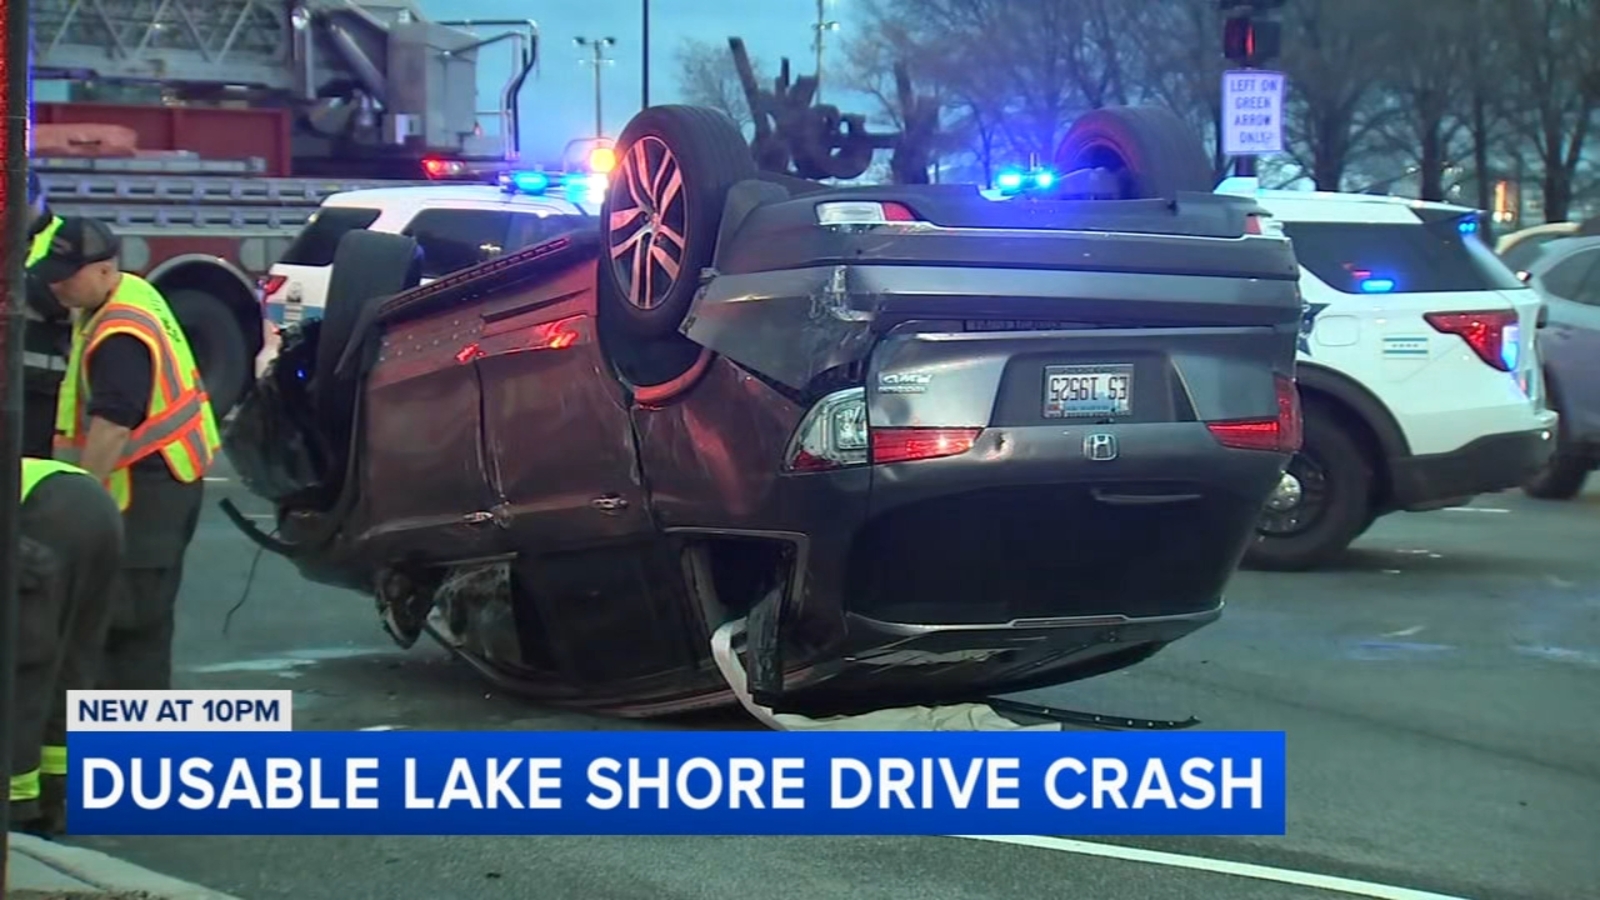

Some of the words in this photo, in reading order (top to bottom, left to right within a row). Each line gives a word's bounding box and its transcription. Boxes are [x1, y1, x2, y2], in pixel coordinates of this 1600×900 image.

[1230, 79, 1256, 93] LEFT
[1261, 79, 1278, 92] ON
[1235, 95, 1272, 110] GREEN
[1234, 113, 1272, 127] ARROW
[1050, 376, 1099, 402] 19525
